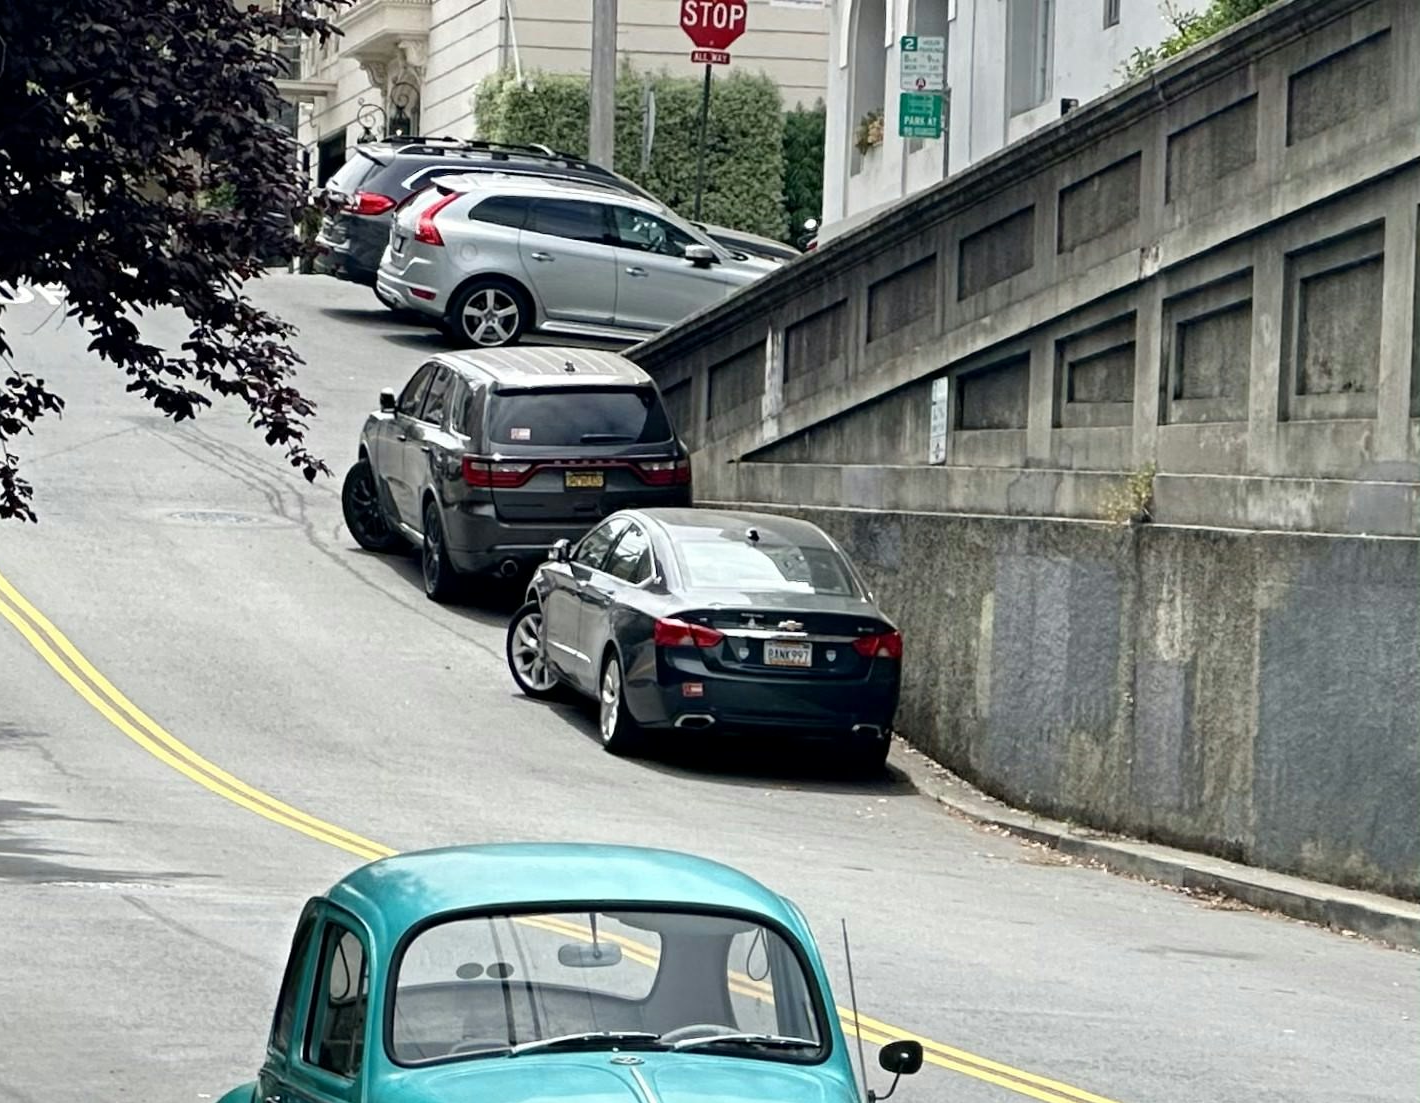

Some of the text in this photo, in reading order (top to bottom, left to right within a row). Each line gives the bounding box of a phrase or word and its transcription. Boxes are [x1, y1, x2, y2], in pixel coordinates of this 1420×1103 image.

[683, 0, 744, 30] STOP
[904, 38, 914, 49] 2
[693, 52, 727, 63] ALL WAY
[904, 116, 937, 126] PARK AT
